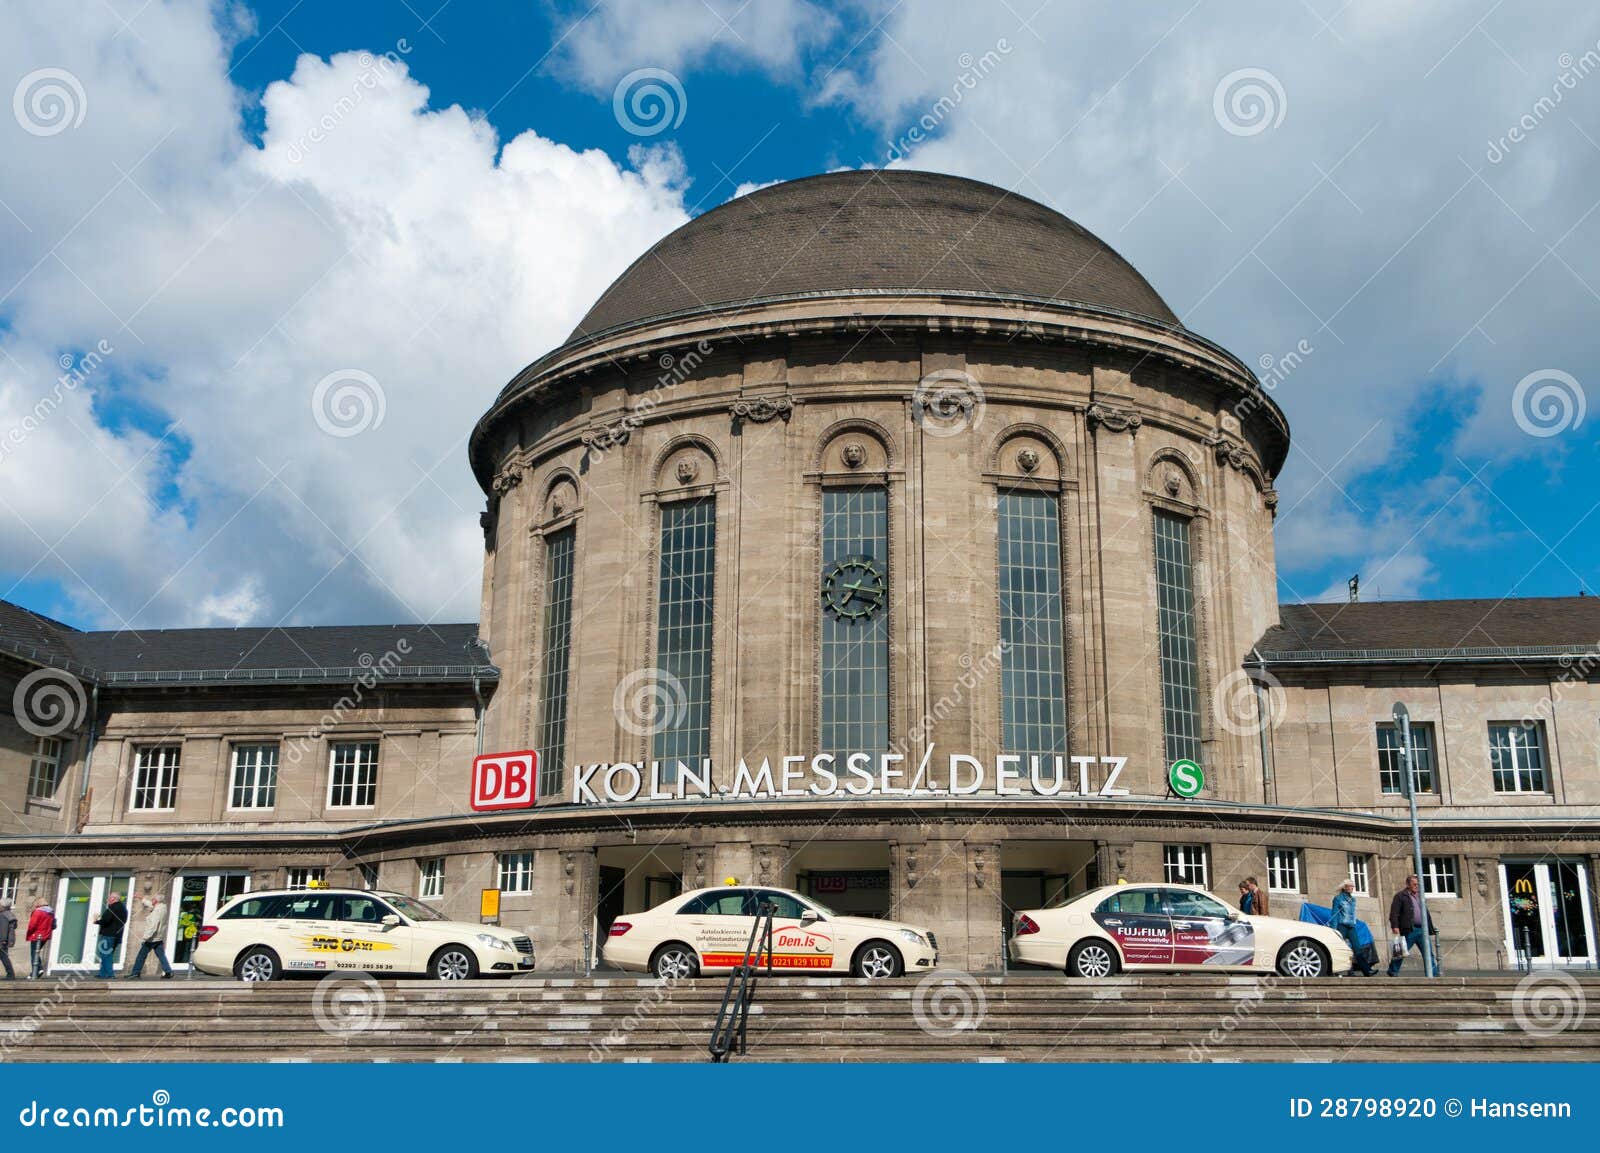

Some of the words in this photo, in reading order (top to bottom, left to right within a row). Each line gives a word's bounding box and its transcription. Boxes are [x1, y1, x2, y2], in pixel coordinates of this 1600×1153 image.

[479, 760, 528, 801] DB
[573, 757, 711, 804] KÖLN
[1176, 763, 1198, 793] S
